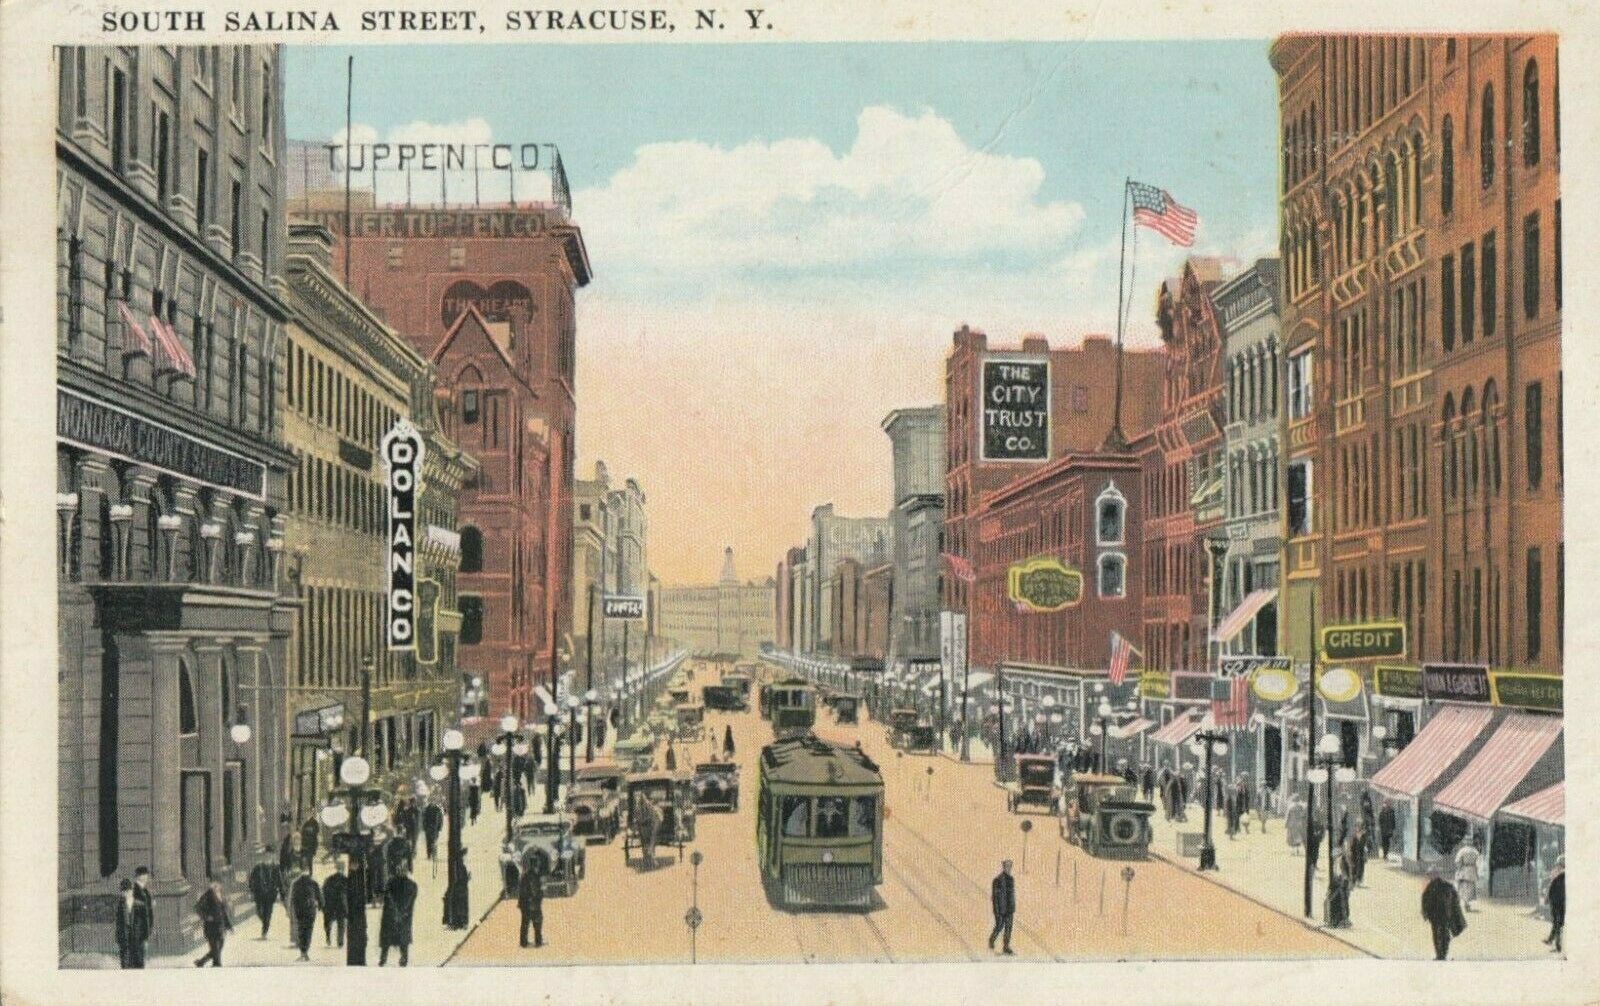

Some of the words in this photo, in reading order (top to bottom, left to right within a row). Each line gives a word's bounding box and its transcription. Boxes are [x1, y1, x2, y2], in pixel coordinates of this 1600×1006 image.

[322, 143, 466, 171] TUPPEN
[1000, 365, 1030, 380] THE
[992, 385, 1041, 403] CITY
[985, 409, 1046, 427] TRUST
[1005, 436, 1036, 450] CO.
[1329, 632, 1394, 647] CREDIT
